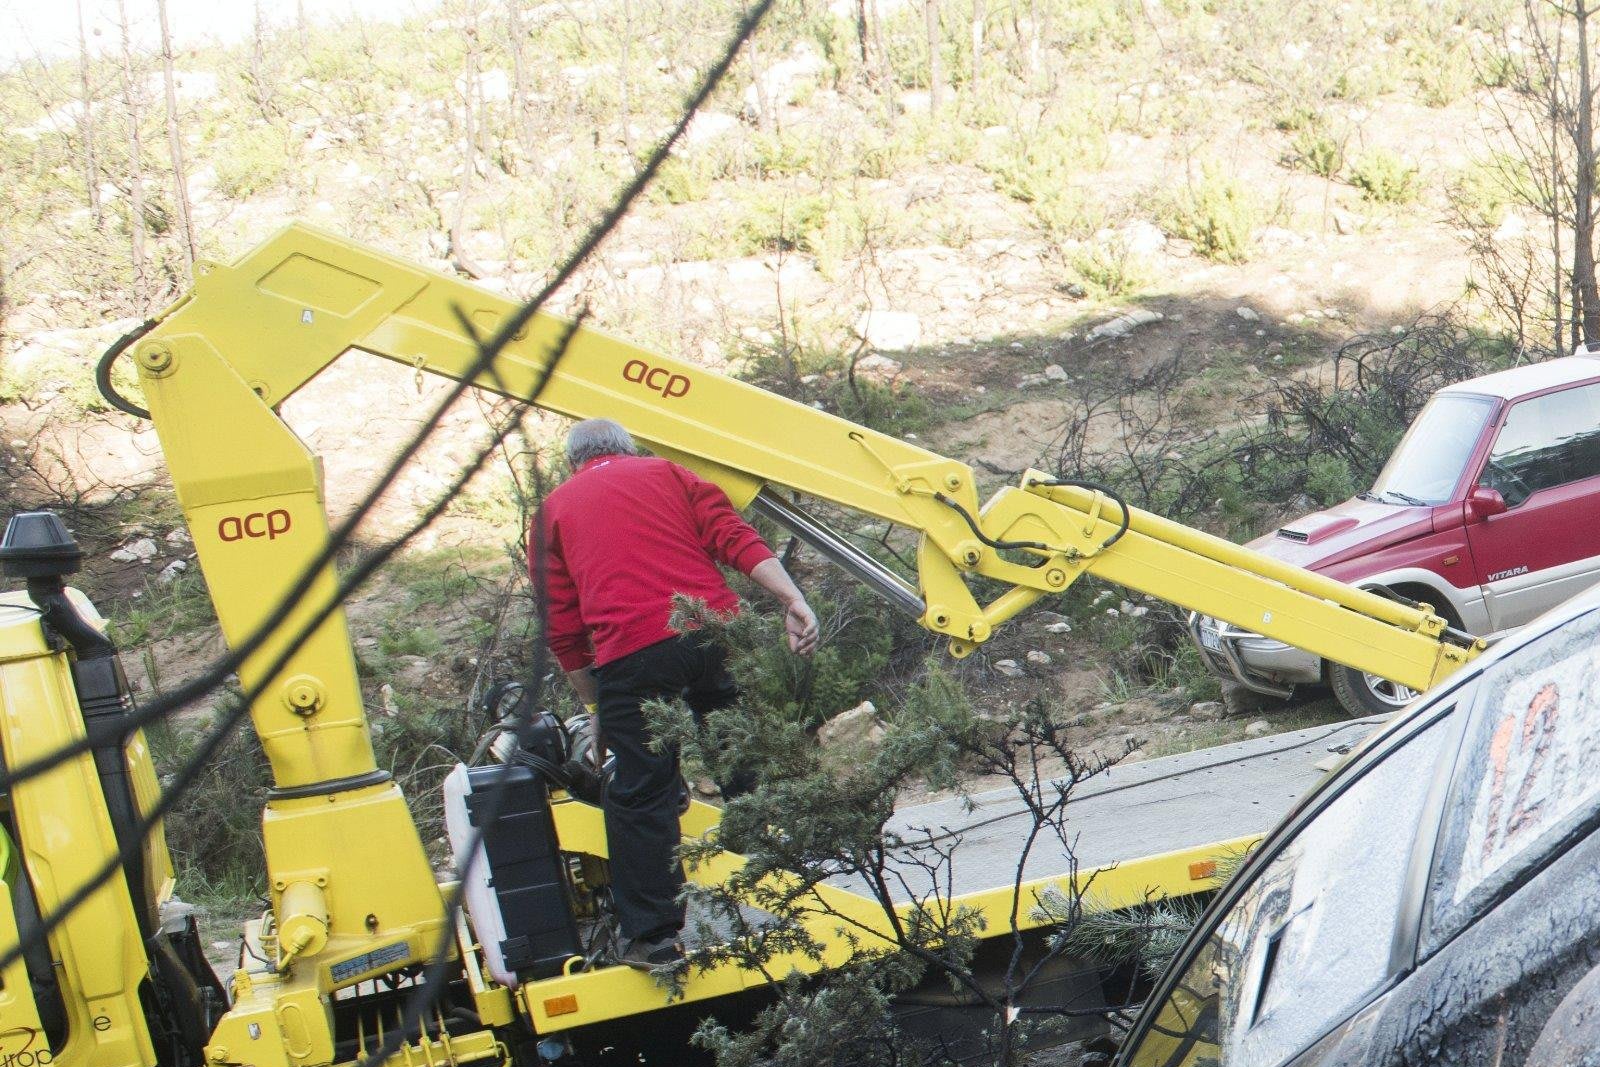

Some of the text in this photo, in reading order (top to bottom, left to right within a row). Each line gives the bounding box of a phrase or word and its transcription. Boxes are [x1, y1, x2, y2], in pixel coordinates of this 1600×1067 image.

[622, 357, 692, 400] acp
[217, 507, 293, 543] acp
[1487, 565, 1529, 582] VITARA
